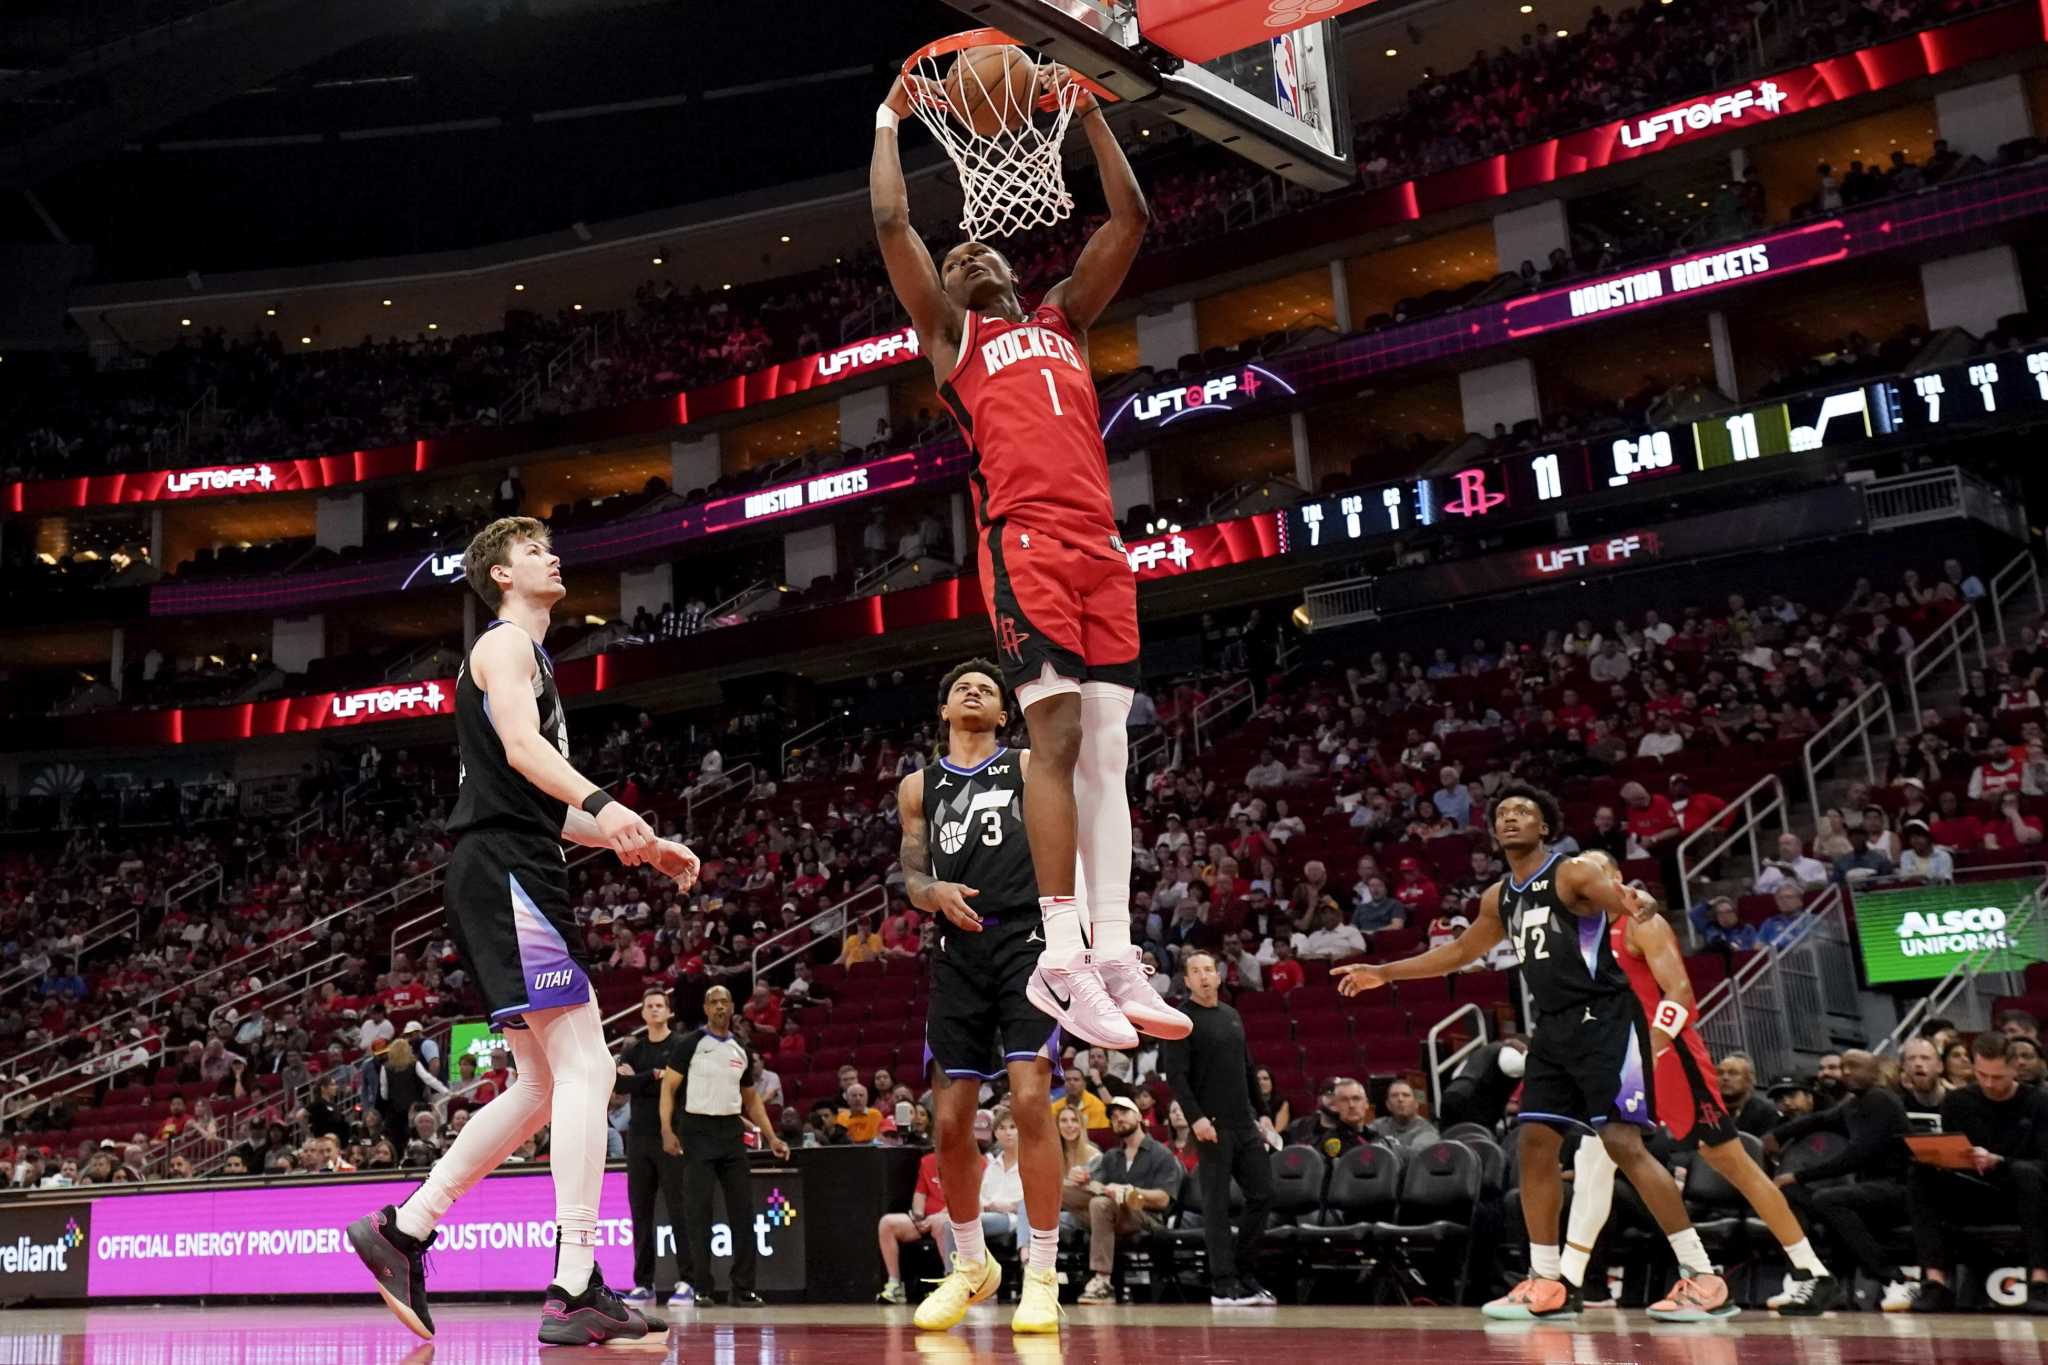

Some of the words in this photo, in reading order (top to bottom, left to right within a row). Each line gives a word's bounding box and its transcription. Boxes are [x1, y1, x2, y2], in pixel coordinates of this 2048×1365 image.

[1620, 89, 1755, 148] LIFTOFF
[1569, 270, 1663, 317] HOUSTON
[1670, 243, 1769, 292] ROCKETS
[818, 334, 903, 376] LIFTOFF
[981, 326, 1083, 376] ROCKETS
[1040, 368, 1064, 416] 1
[1133, 375, 1237, 421] LIFTOFF
[1924, 393, 1941, 423] 7
[1979, 382, 1997, 412] 1
[1725, 412, 1760, 462] 11
[167, 467, 256, 492] LIFTOFF
[807, 468, 869, 504] ROCKETS
[1531, 453, 1562, 500] 11
[1388, 505, 1400, 531] 1
[1535, 535, 1641, 573] LIFTOFF
[332, 687, 424, 718] LIFTOFF
[987, 764, 1011, 776] LVT
[980, 810, 1003, 847] 3
[1896, 906, 2007, 938] ALSCO
[1530, 927, 1550, 960] 2
[534, 968, 574, 990] UTAH
[1660, 1006, 1678, 1027] 9
[97, 1233, 173, 1260] OFFICIAL
[175, 1231, 246, 1257] ENERGY
[247, 1228, 340, 1256] PROVIDER
[426, 1222, 525, 1251] OUSTON
[527, 1218, 634, 1248] ROETS
